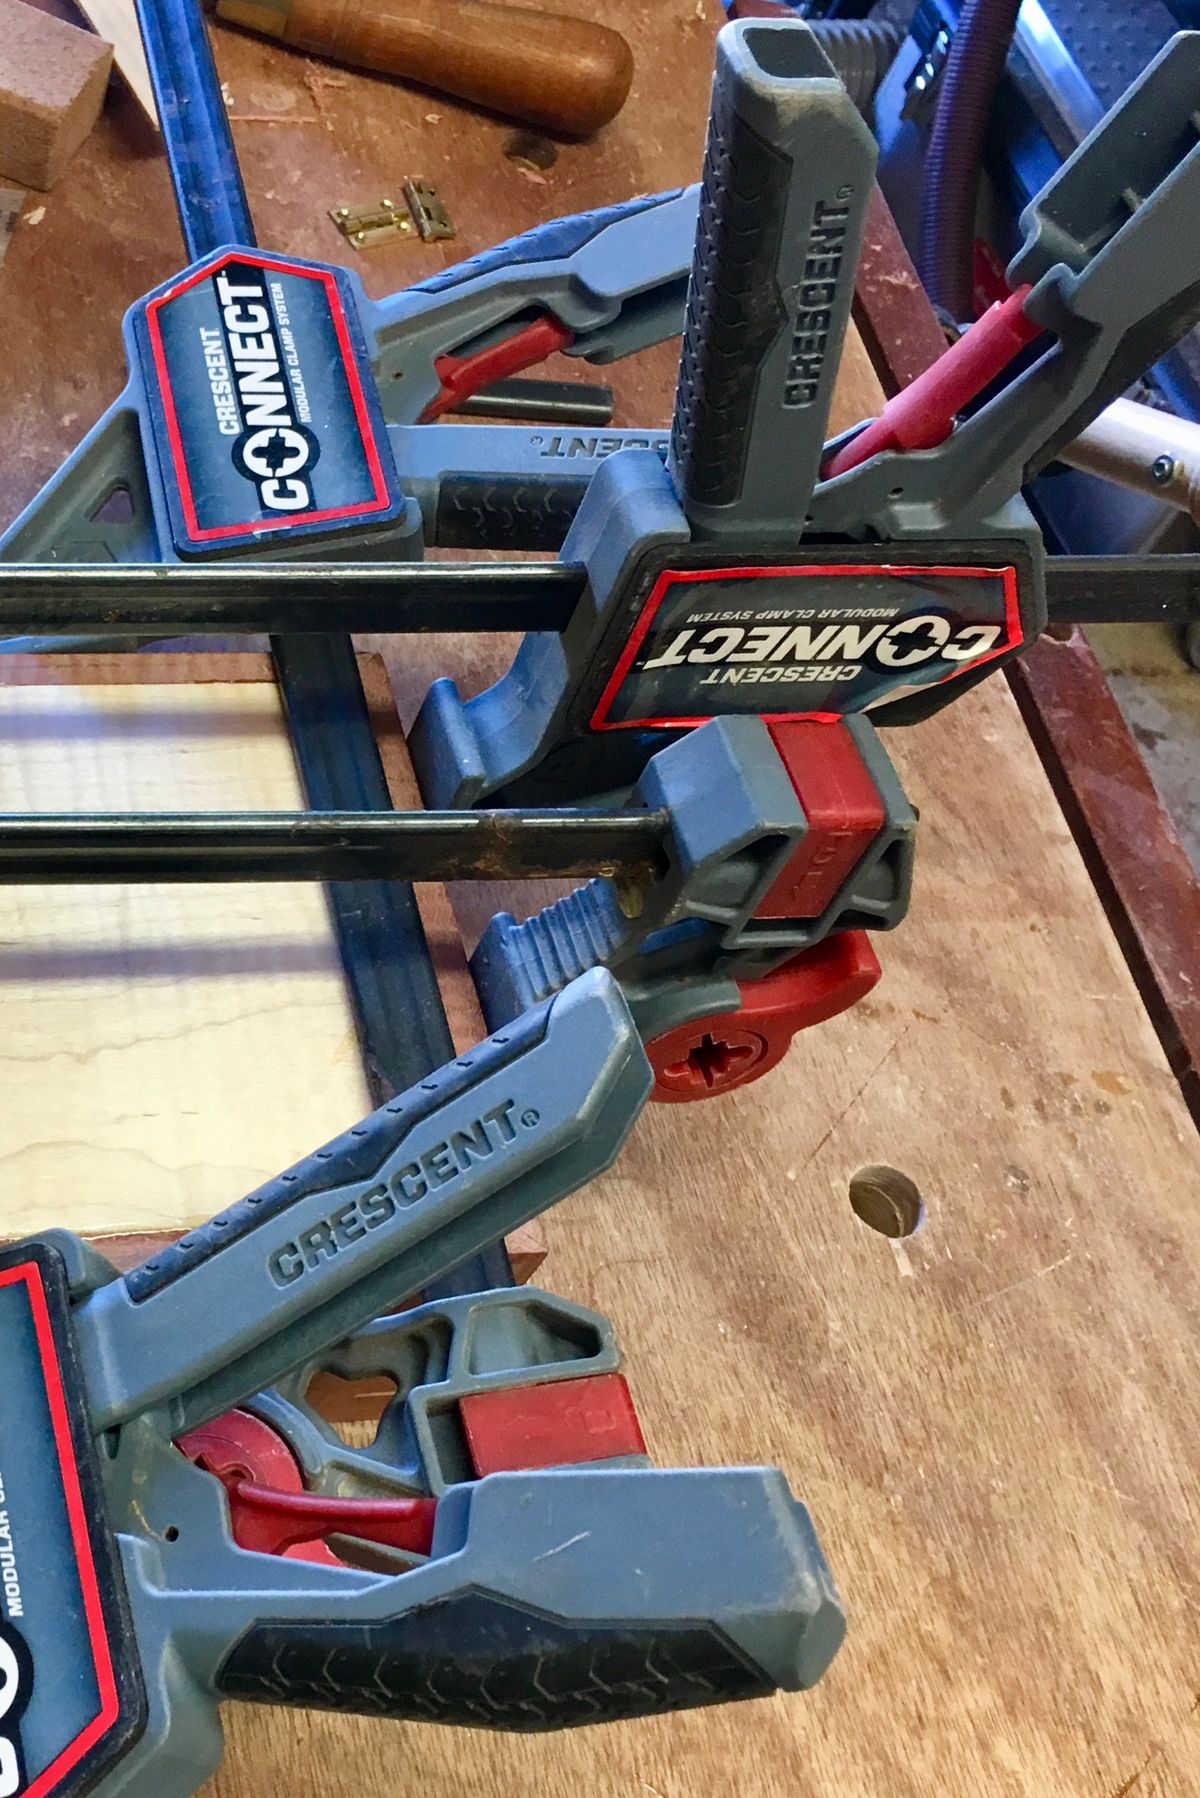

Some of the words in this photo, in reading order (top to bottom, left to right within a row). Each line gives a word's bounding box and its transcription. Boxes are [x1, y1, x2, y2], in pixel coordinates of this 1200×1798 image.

[271, 283, 289, 325] SYSTEM
[782, 199, 850, 408] CRESCENT
[283, 328, 299, 366] CLAMP
[200, 327, 241, 436] CRESCENT
[216, 276, 310, 511] CONNECT
[290, 368, 312, 423] MODULAR
[687, 610, 752, 624] SYSTEM
[755, 608, 816, 621] CLAMP
[818, 607, 901, 619] MODULAR
[643, 615, 1002, 670] CONNECT
[700, 664, 862, 686] CRESCENT
[267, 1098, 518, 1288] CRESCENT
